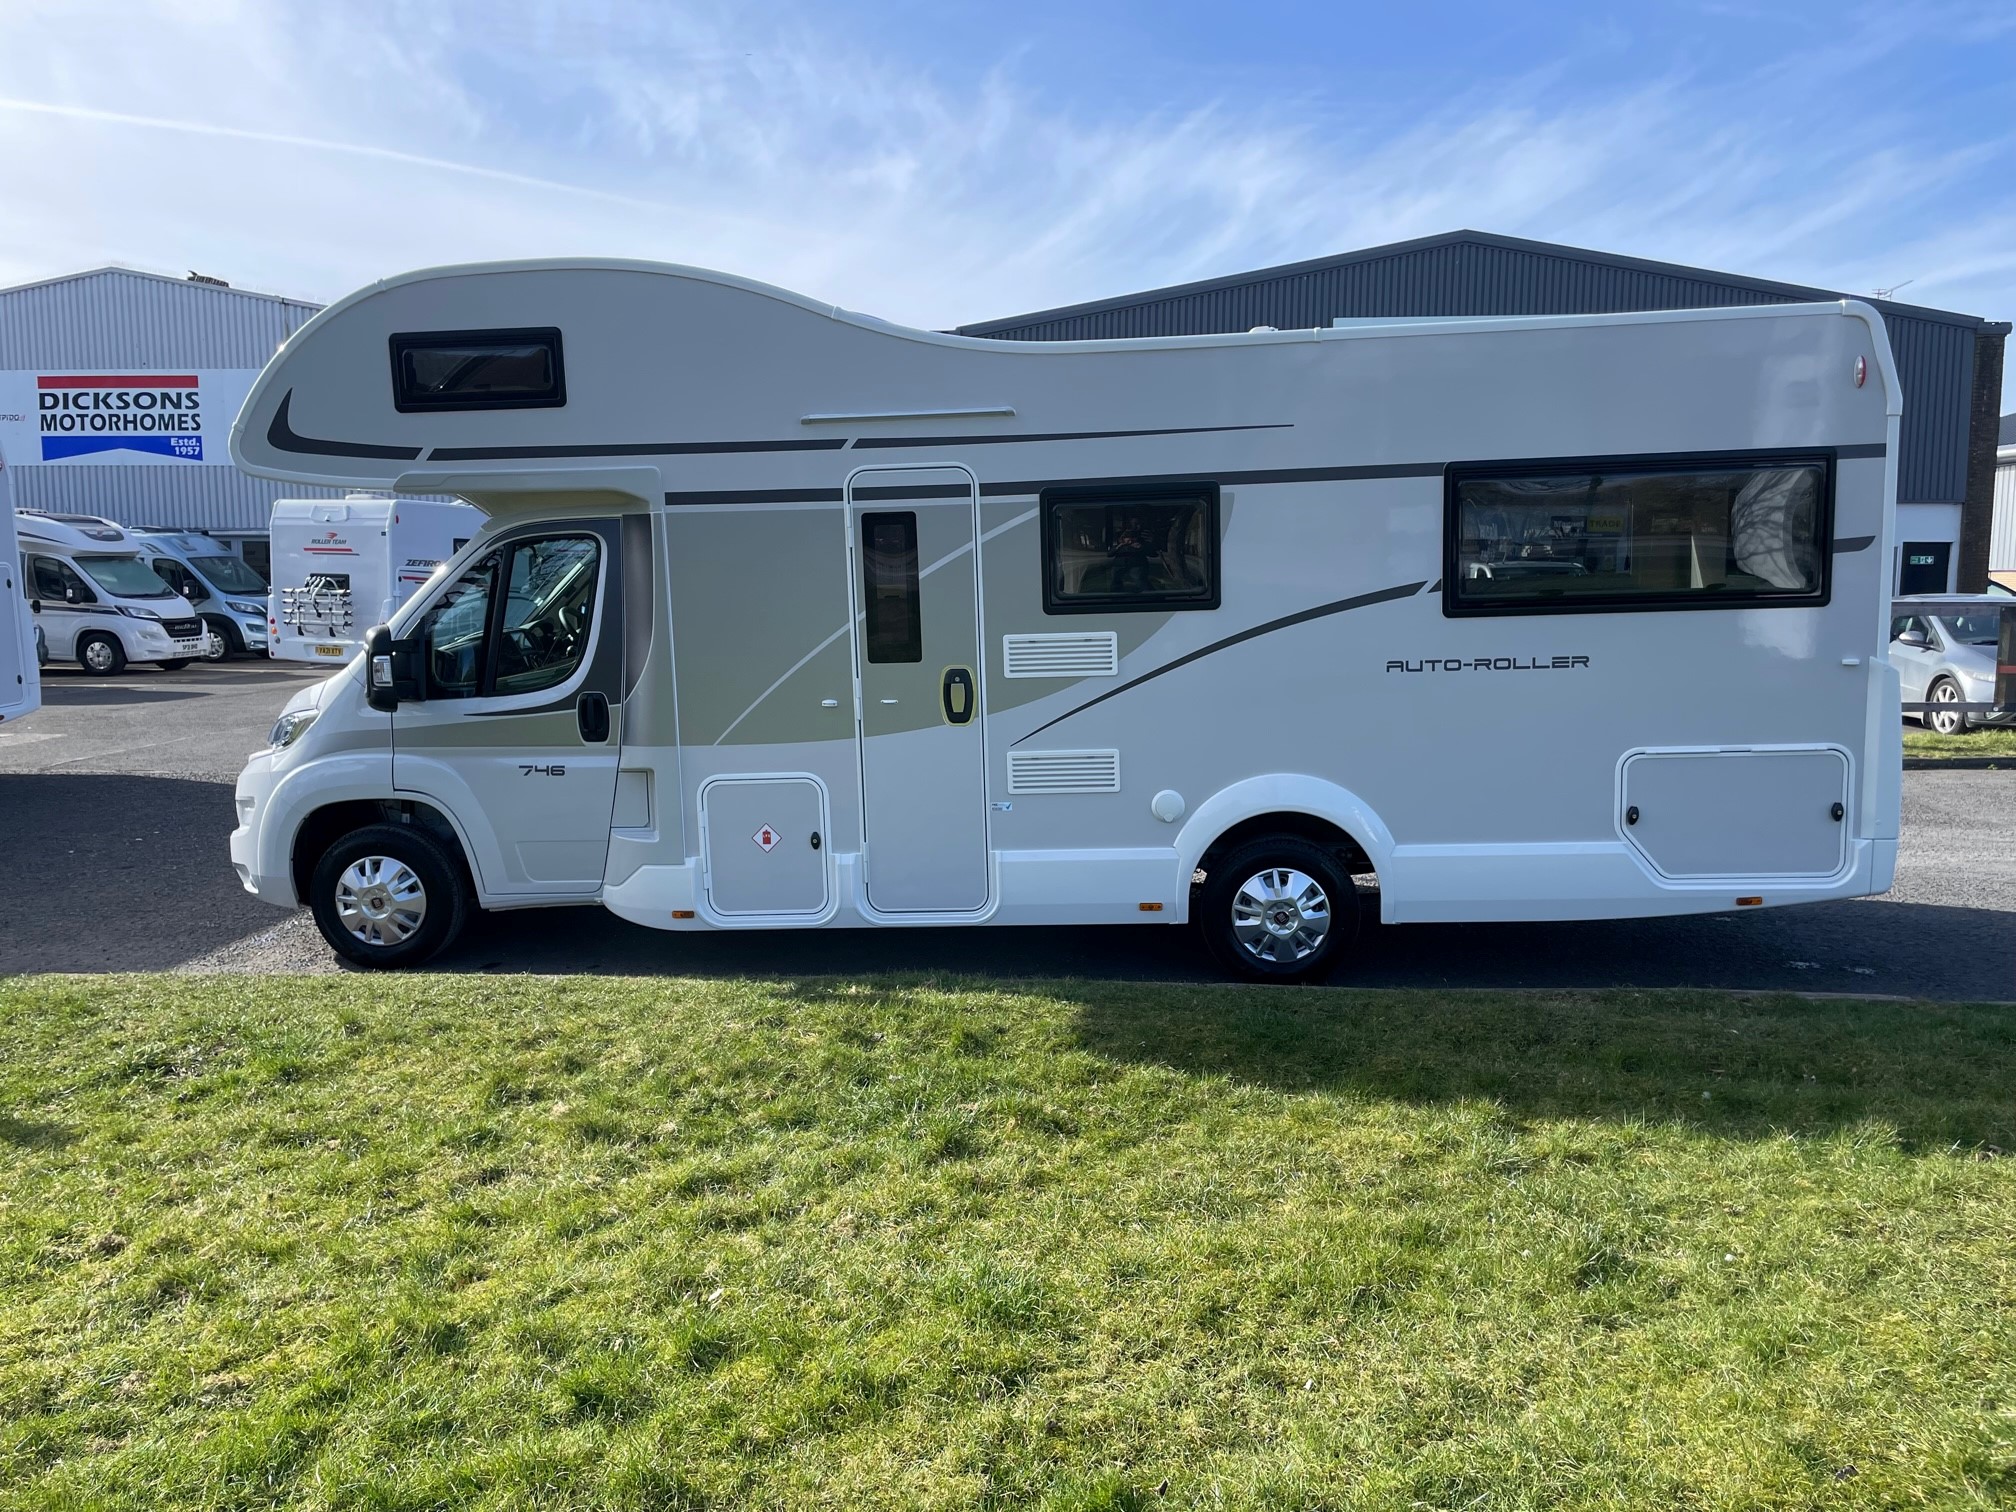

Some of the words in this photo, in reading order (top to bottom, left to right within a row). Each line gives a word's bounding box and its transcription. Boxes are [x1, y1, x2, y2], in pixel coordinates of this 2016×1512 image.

[39, 392, 200, 410] DICKSONS
[40, 413, 201, 432] MOTORHOMES
[170, 437, 200, 446] Estd.
[174, 447, 200, 456] 1957
[1386, 655, 1590, 673] AUTO-ROLLER
[518, 765, 566, 776] 746
